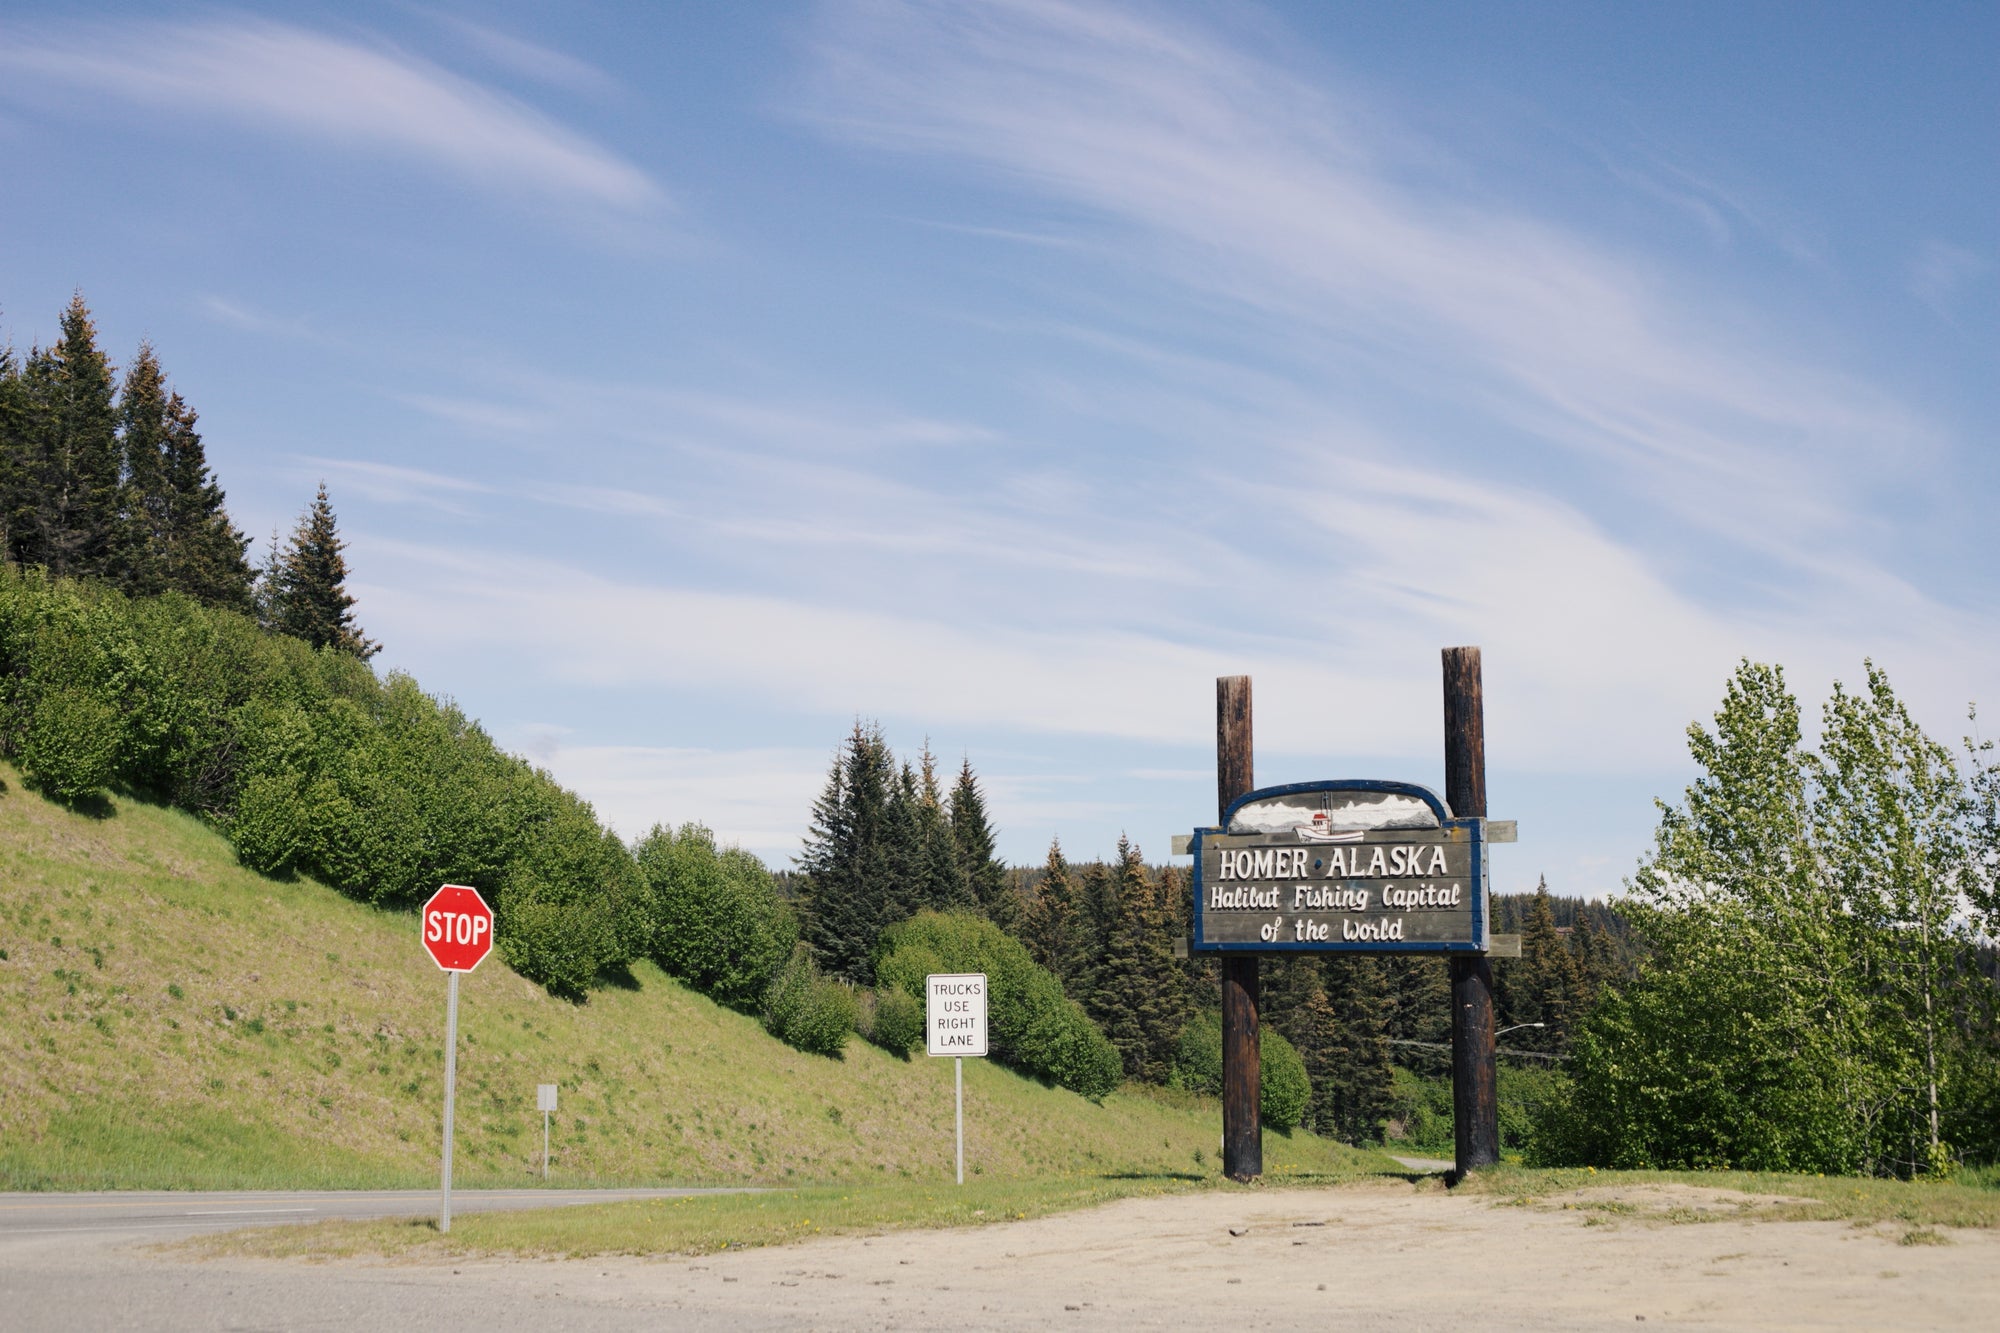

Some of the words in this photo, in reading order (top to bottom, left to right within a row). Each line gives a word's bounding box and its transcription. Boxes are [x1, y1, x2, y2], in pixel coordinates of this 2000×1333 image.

[1219, 847, 1309, 880] HOMER
[1326, 845, 1448, 878] ALASKA
[1210, 886, 1280, 910] Halibut
[1294, 884, 1369, 911] Fishing
[1382, 883, 1460, 912] Capital
[427, 910, 488, 946] STOP
[1260, 916, 1283, 943] of
[1295, 918, 1329, 941] the
[1343, 918, 1404, 942] World
[933, 983, 981, 995] TRUCKS
[944, 1001, 969, 1012] USE
[938, 1018, 976, 1029] RIGHT
[940, 1035, 974, 1046] LANE
